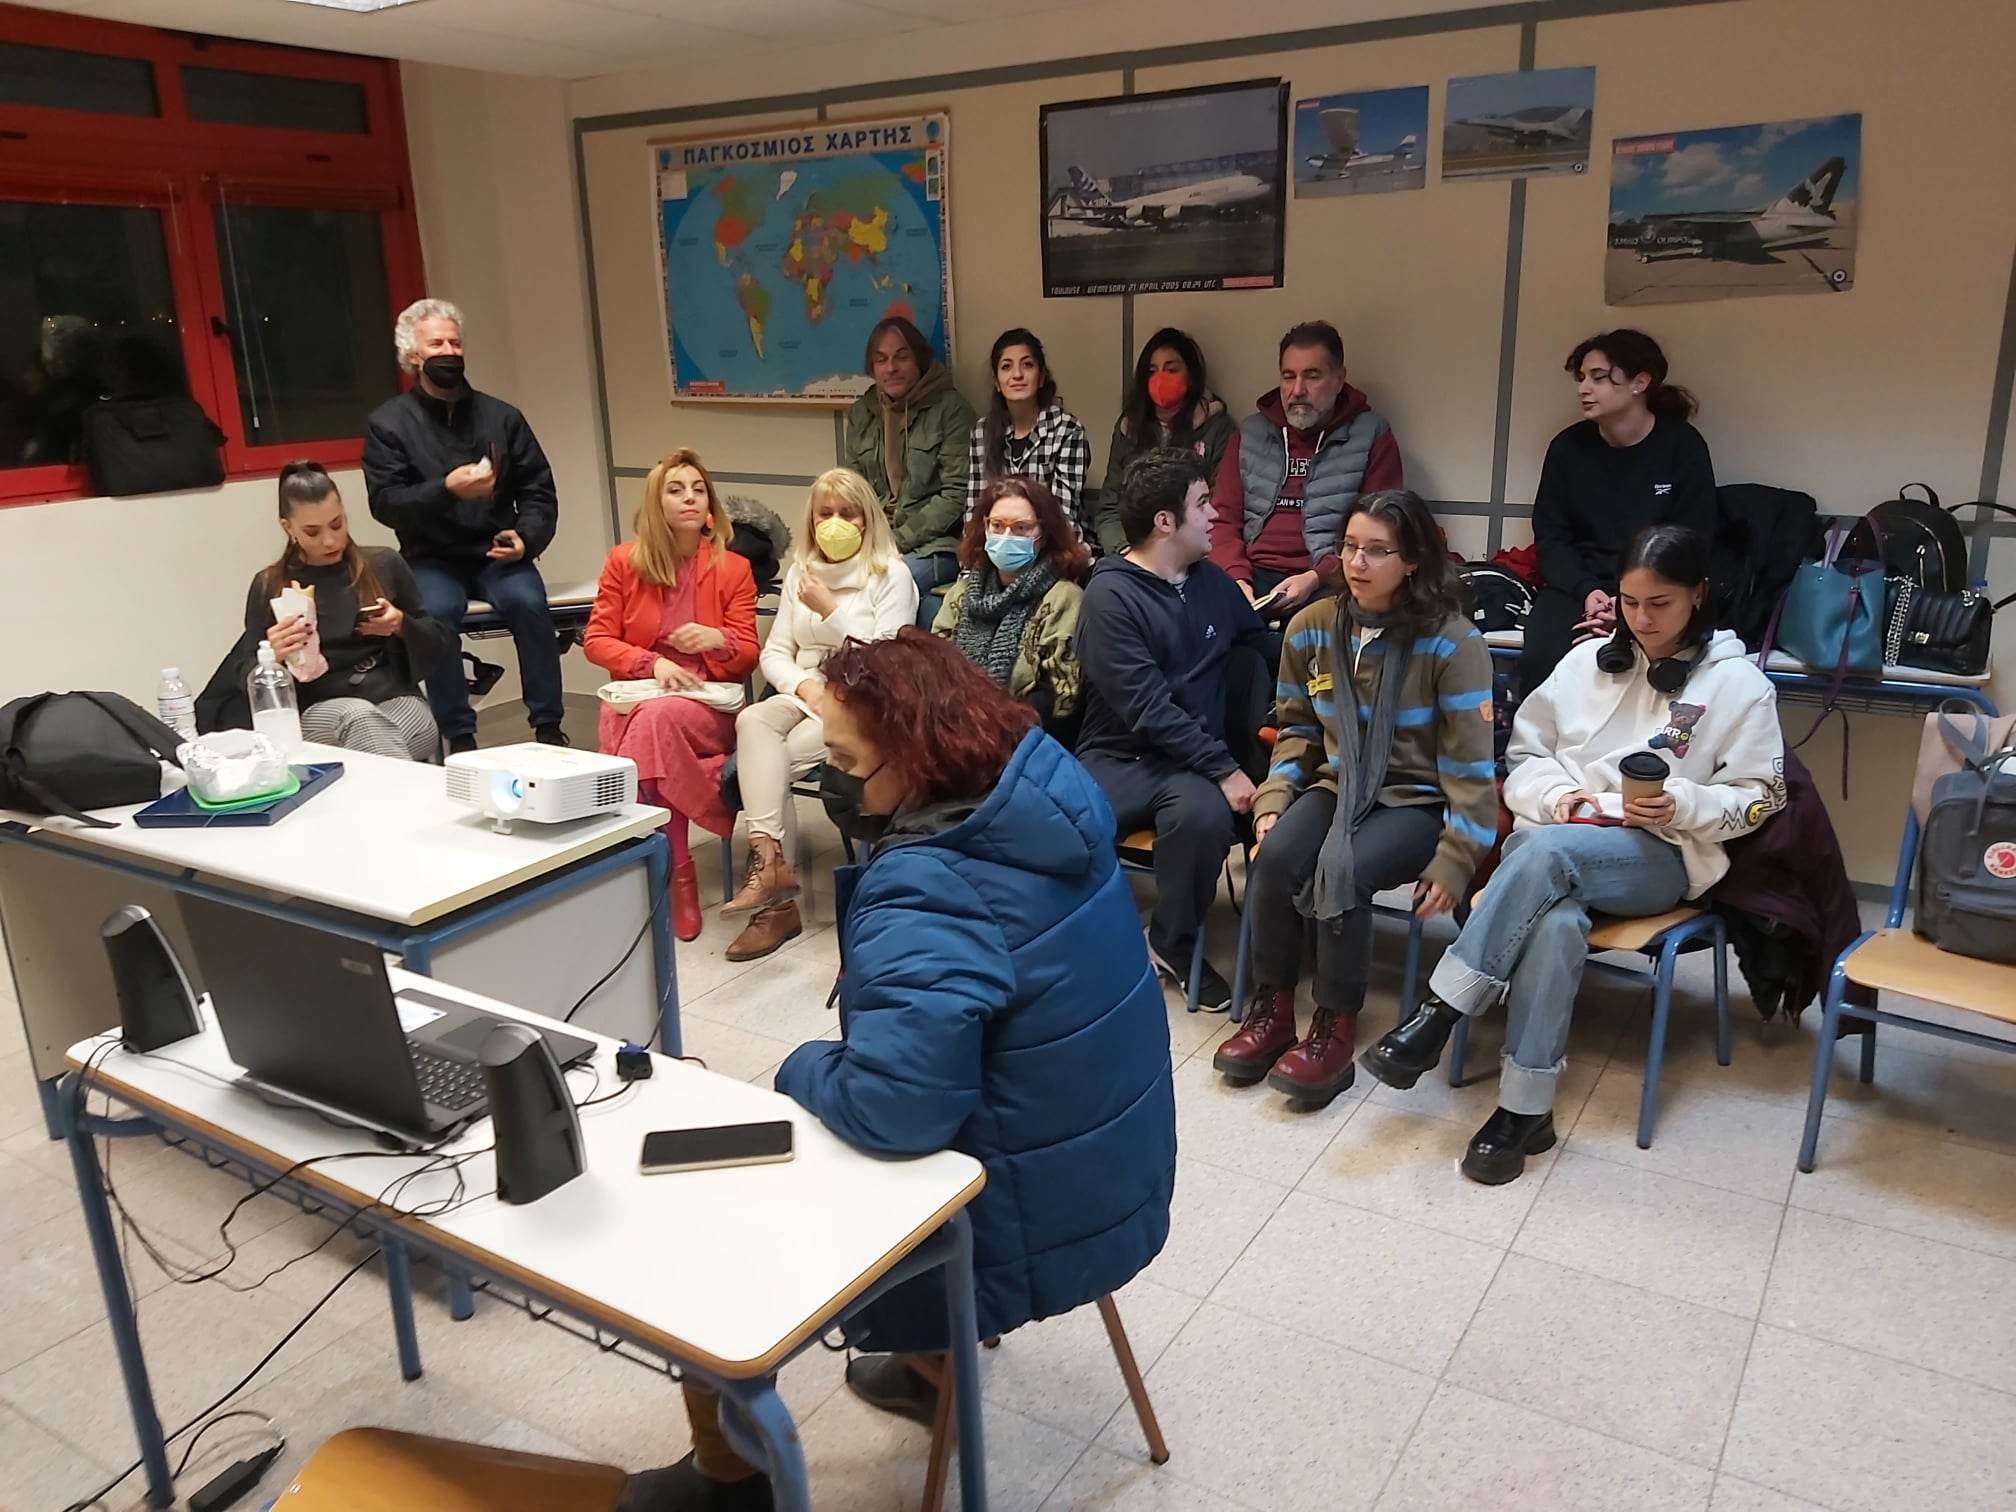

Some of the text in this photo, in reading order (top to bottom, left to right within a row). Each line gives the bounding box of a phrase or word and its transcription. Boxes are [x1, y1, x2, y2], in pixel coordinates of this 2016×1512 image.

[683, 125, 912, 165] ΠΑΓΚΟΣΜΙΟΣ ΧΑΡΤΗΣ
[1139, 281, 1159, 292] APRIL
